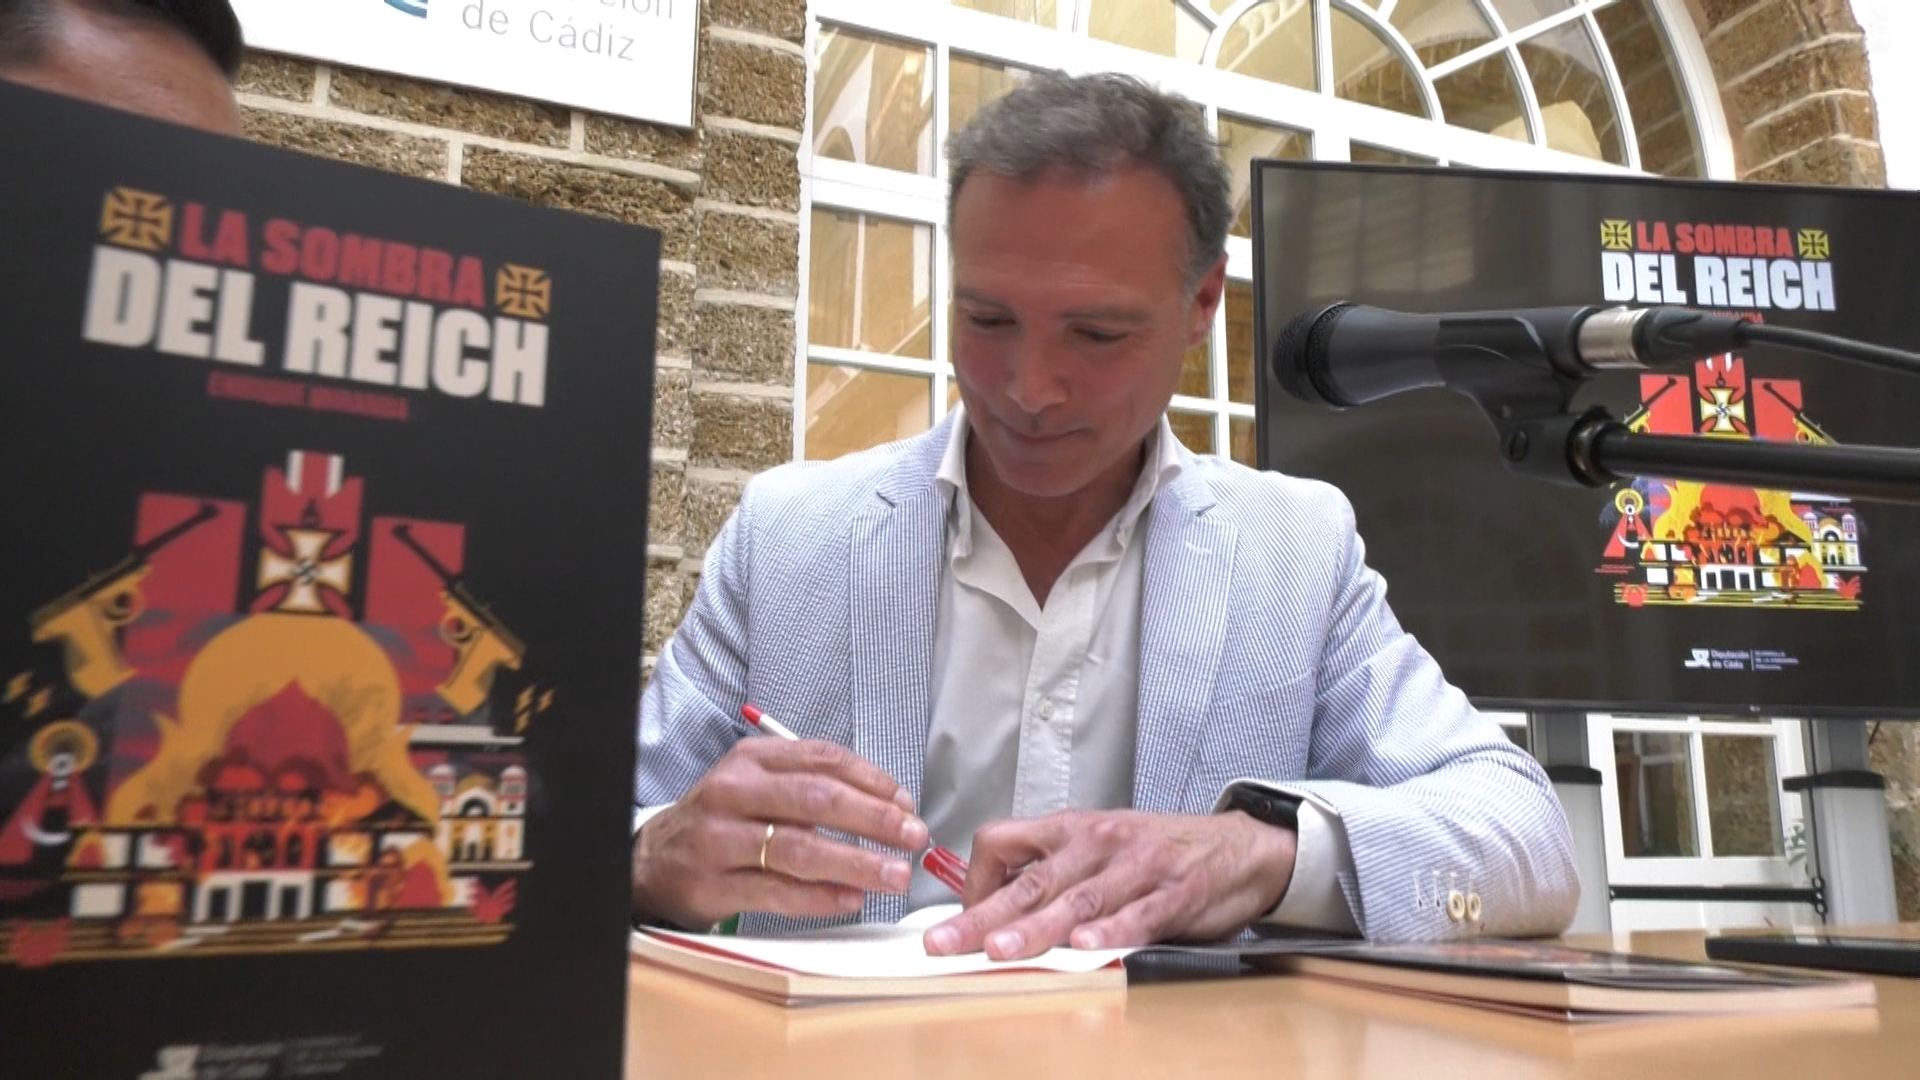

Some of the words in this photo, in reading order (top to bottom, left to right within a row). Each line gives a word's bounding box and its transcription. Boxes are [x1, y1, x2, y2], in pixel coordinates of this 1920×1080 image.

[462, 0, 509, 35] de
[529, 9, 635, 62] Cádiz
[179, 203, 249, 267] LA
[261, 217, 485, 308] SOMBRA
[1636, 219, 1670, 253] LA
[1675, 221, 1794, 257] SOMBRA
[1601, 252, 1687, 305] DEL
[1694, 256, 1836, 311] REICH
[82, 244, 265, 366] DEL
[282, 281, 549, 406] REICH
